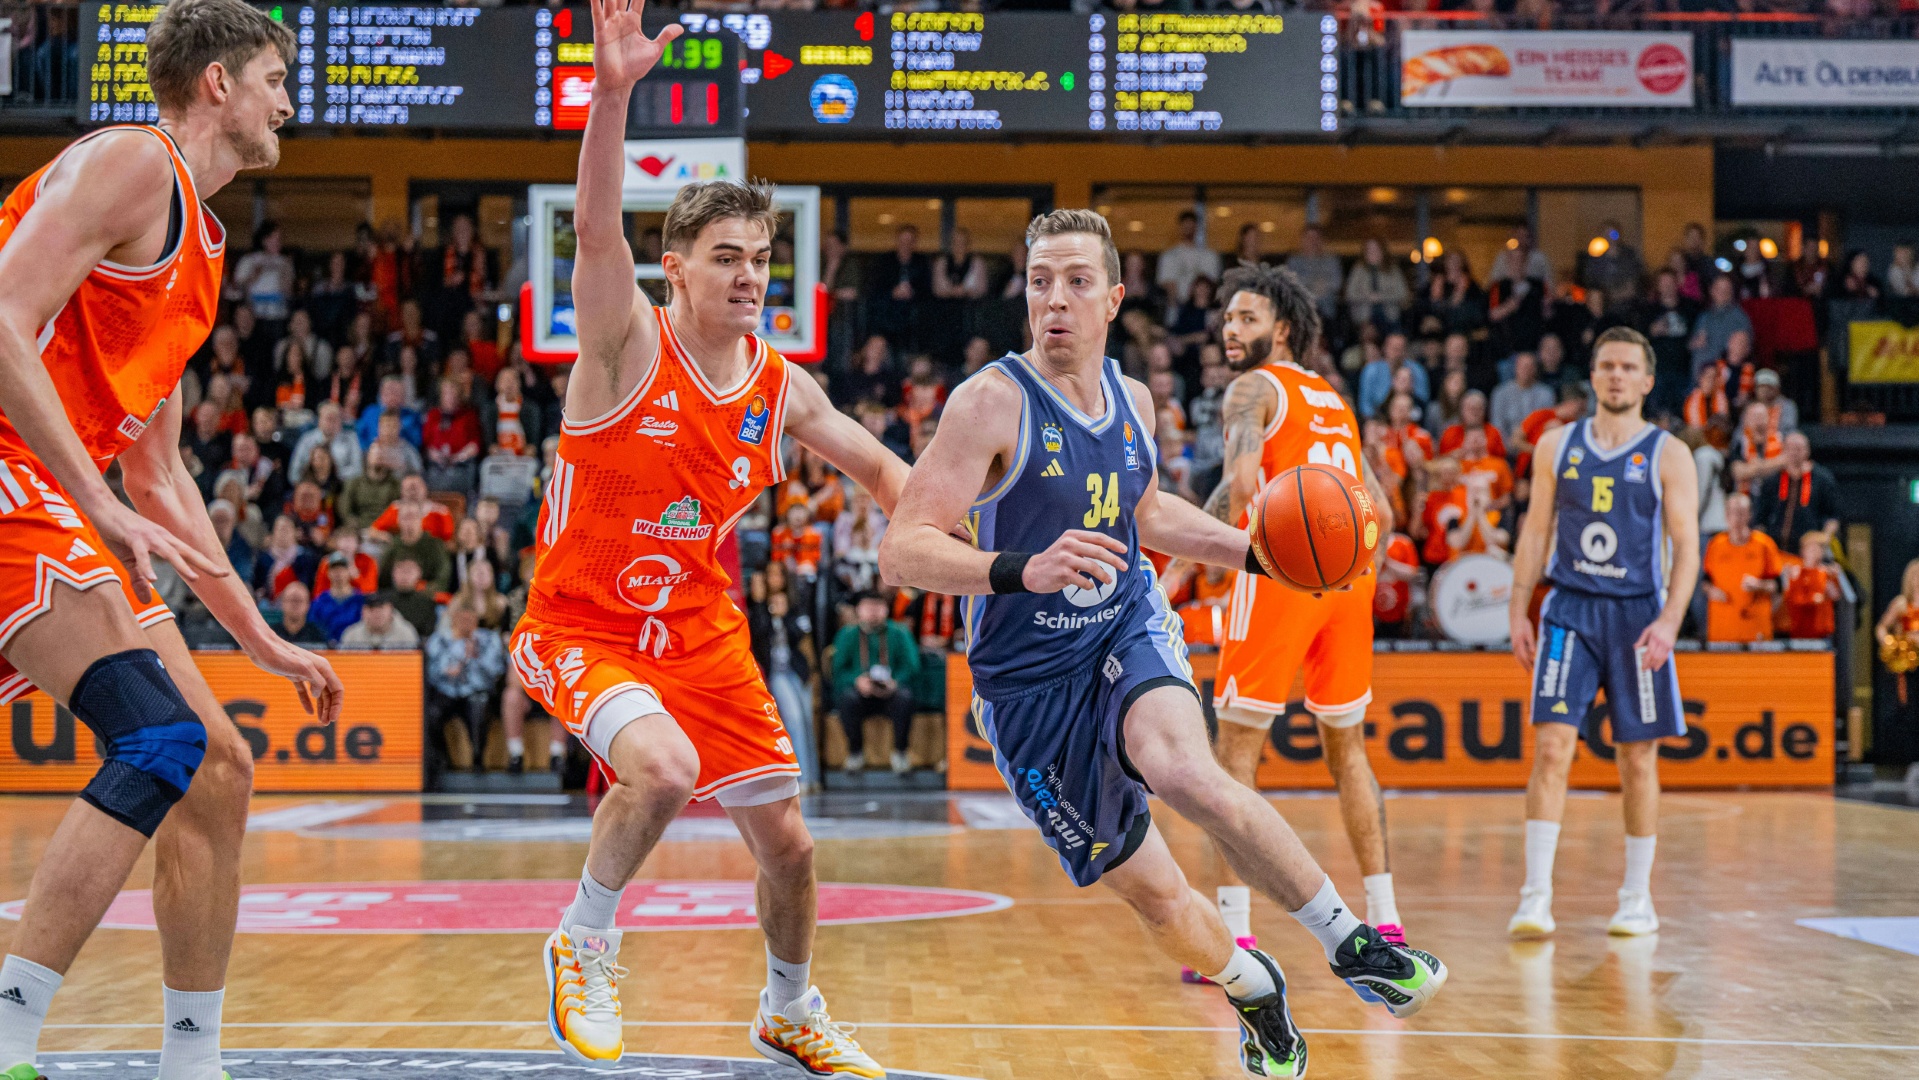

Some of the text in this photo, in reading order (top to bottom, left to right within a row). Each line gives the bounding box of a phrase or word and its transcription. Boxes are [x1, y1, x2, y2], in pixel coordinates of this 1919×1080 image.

[1755, 61, 1805, 86] ALTE
[678, 164, 728, 178] AIDA
[741, 427, 759, 442] BBL
[1083, 472, 1121, 529] 34
[1591, 476, 1615, 513] 15
[1355, 490, 1374, 517] BBL
[634, 523, 716, 539] WIESENHOF
[626, 571, 694, 588] MIAVIT
[172, 1023, 200, 1032] adidas
